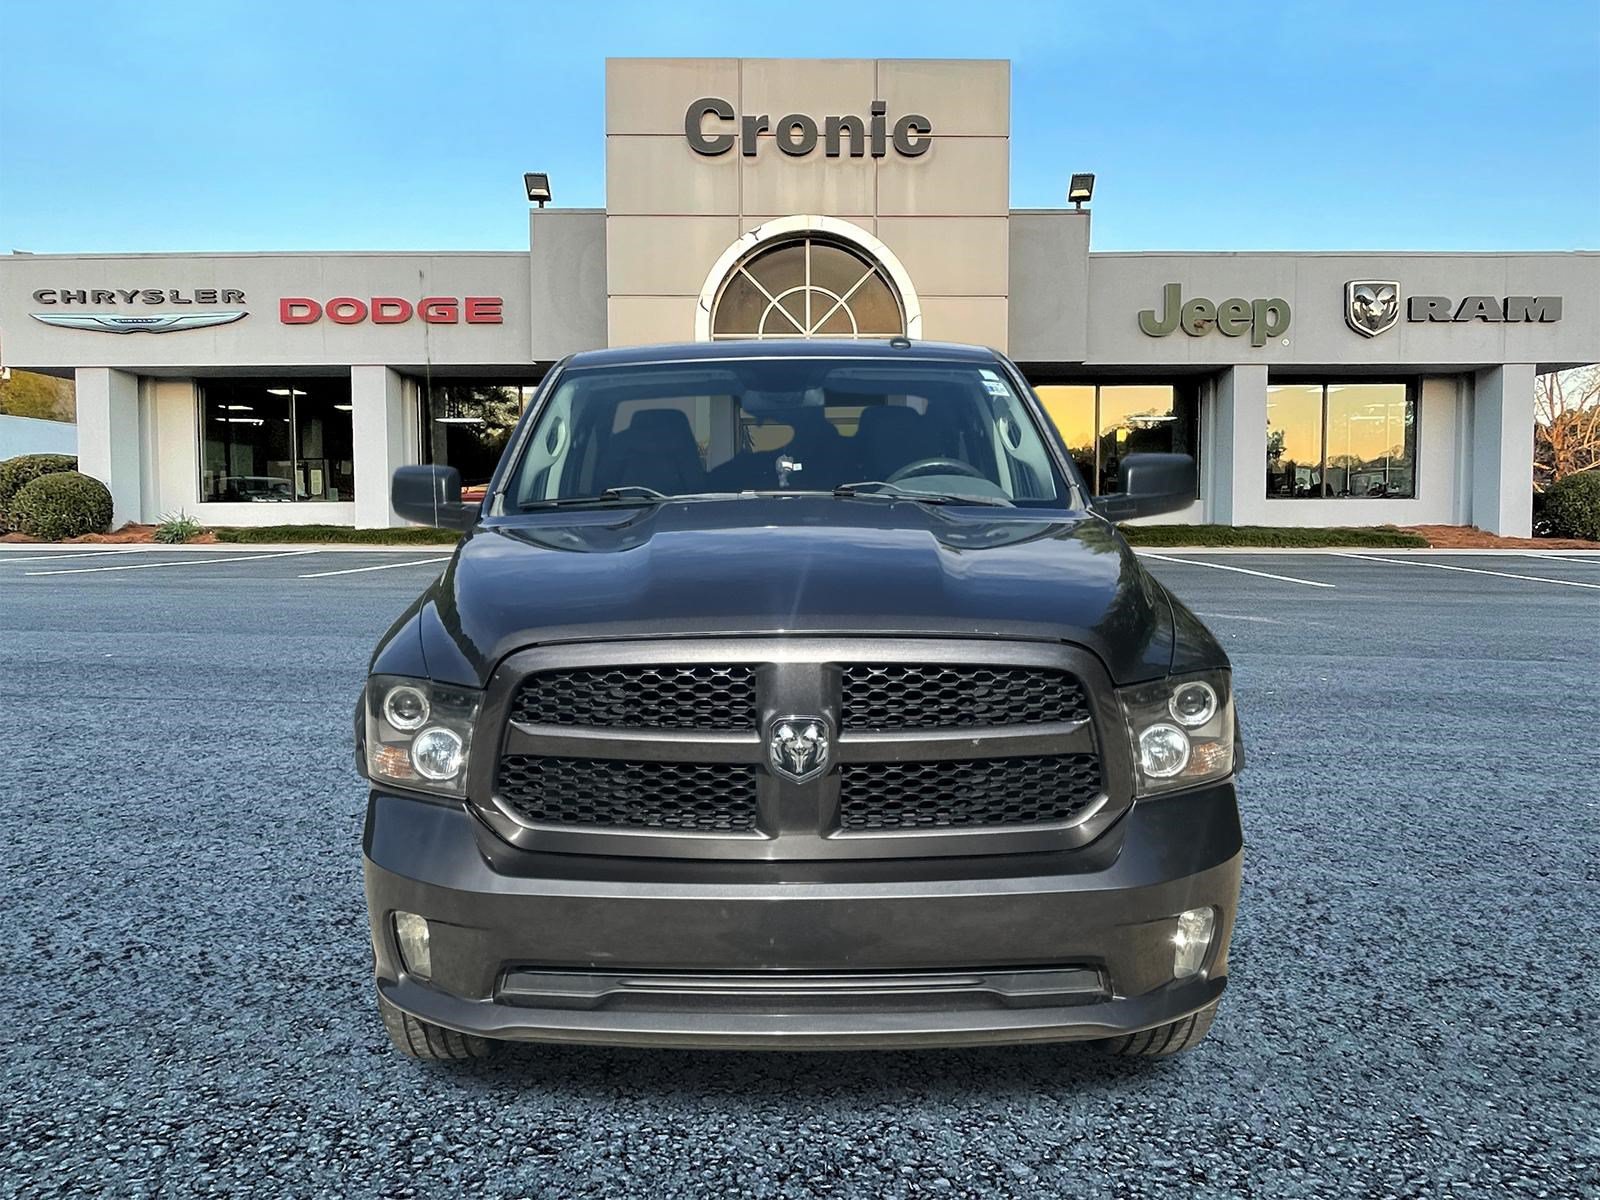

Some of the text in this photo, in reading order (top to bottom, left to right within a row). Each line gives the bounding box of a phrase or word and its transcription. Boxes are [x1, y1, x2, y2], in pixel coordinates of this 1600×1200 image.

[685, 97, 932, 157] Cronic
[32, 288, 246, 305] CHRYSLER
[280, 296, 504, 325] DODGE
[1407, 295, 1563, 323] RAM
[1138, 282, 1291, 347] Jeep
